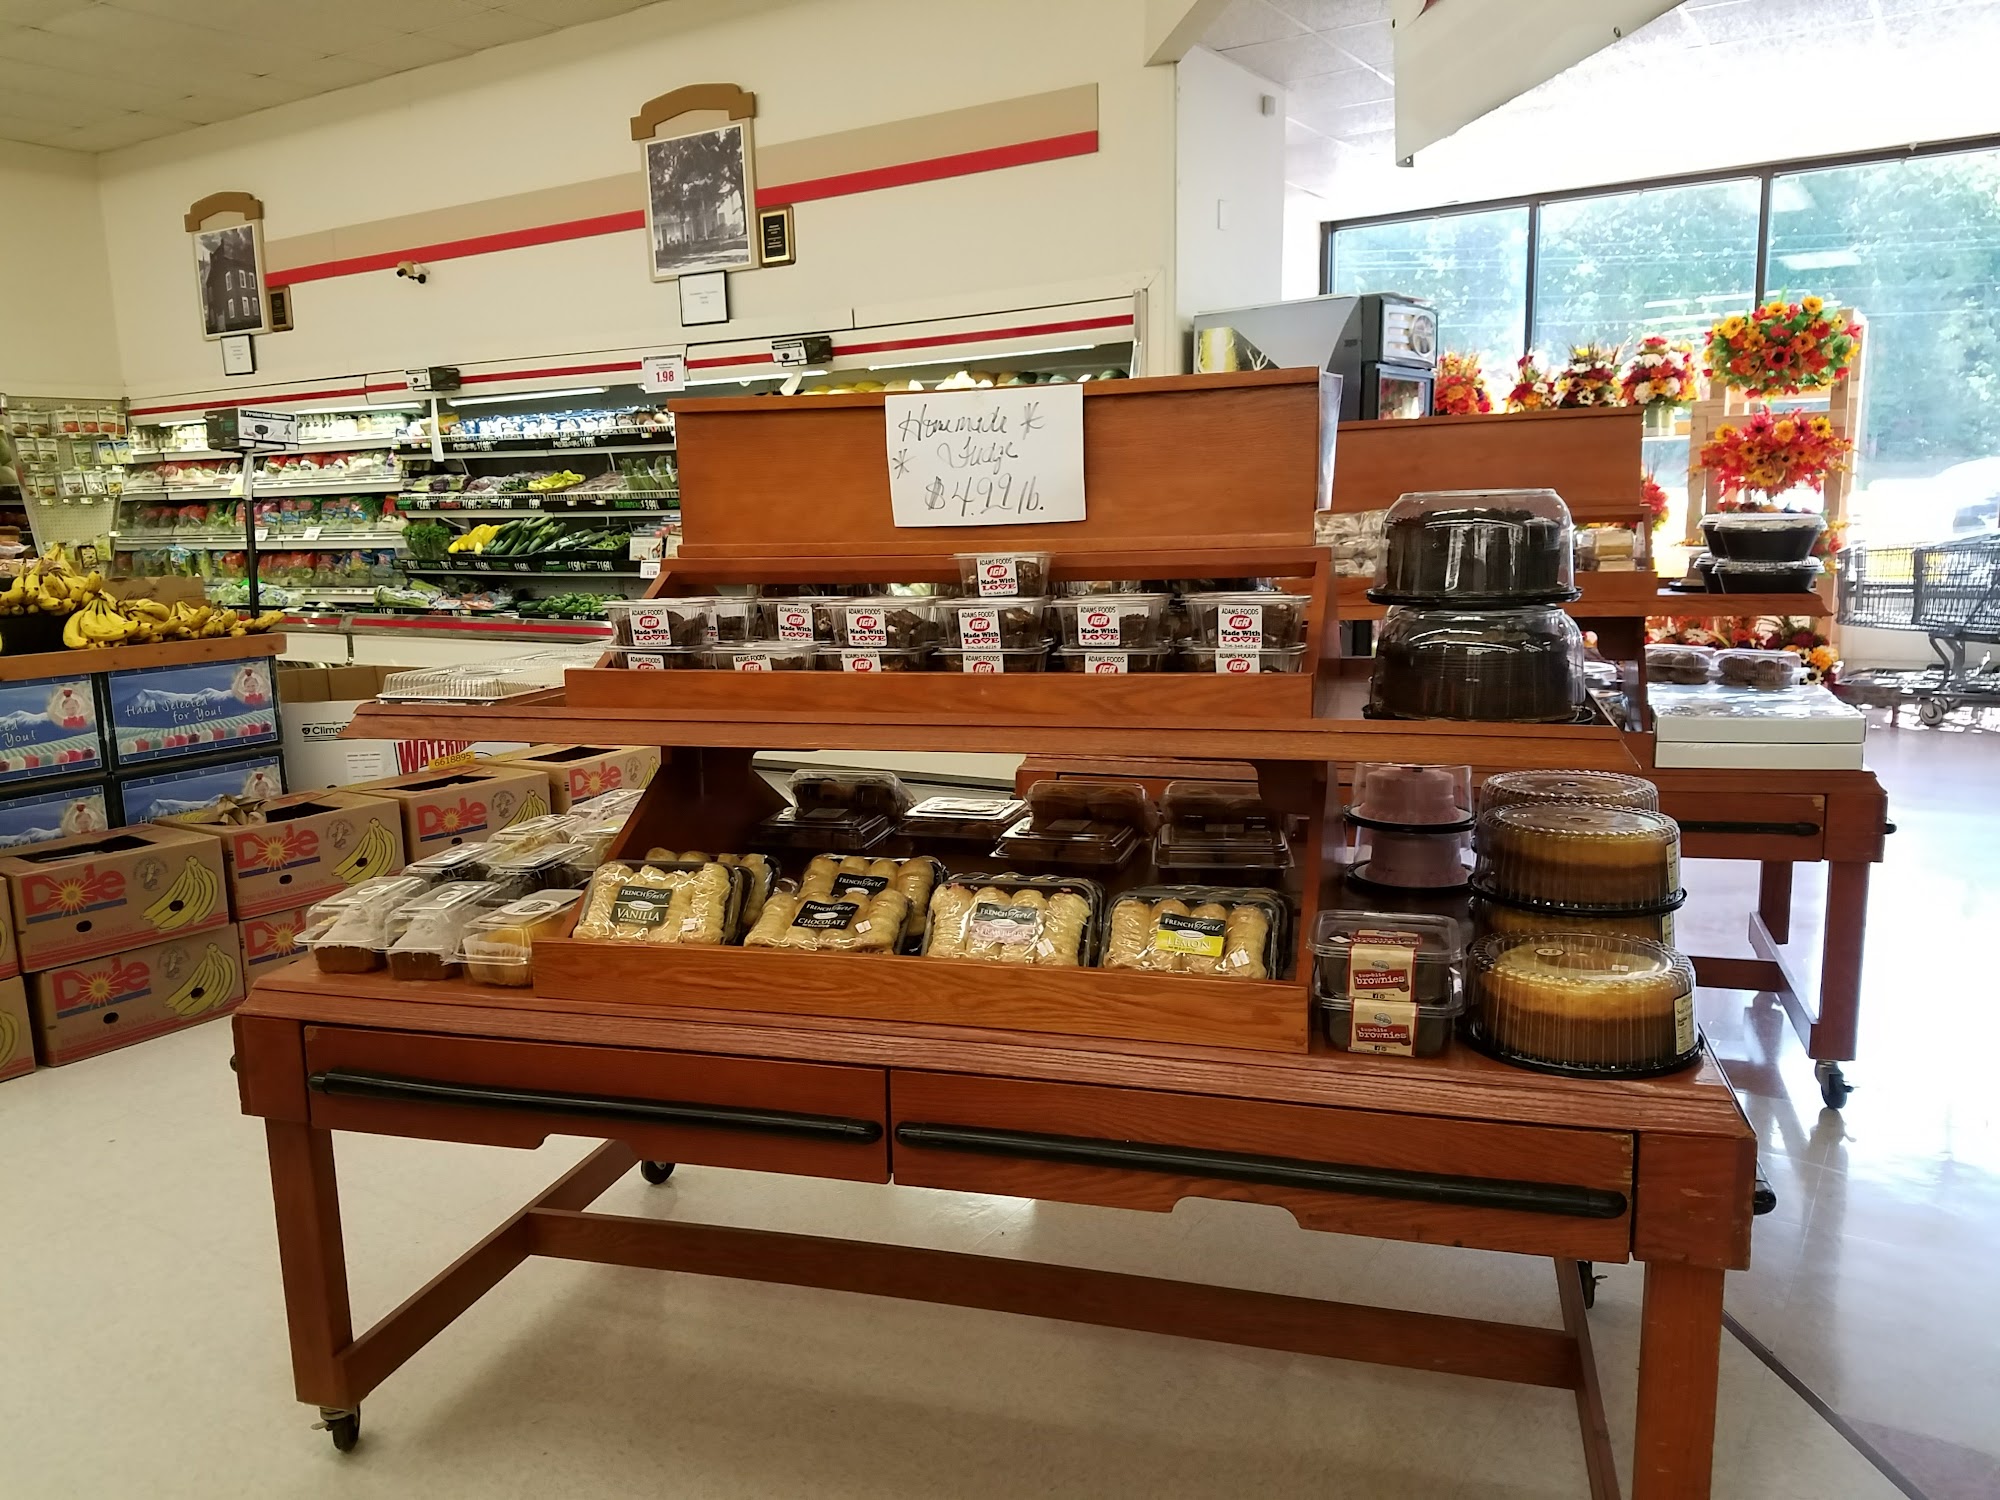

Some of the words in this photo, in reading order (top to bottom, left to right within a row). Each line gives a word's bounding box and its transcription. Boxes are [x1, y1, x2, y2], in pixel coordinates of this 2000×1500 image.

[656, 370, 675, 382] 1.98
[898, 404, 1008, 442] Homemade
[937, 436, 1019, 475] Fudge
[925, 473, 1013, 517] $4.99
[979, 558, 994, 566] ADAMS
[995, 557, 1012, 565] FOODS
[989, 566, 1005, 577] IGA
[978, 610, 995, 618] FOODS
[1098, 606, 1116, 614] FOODS
[641, 616, 657, 628] IGA
[788, 615, 804, 625] IGA
[858, 617, 875, 627] IGA
[971, 619, 988, 630] IGA
[1090, 615, 1108, 626] IGA
[1230, 617, 1251, 627] IGA
[854, 660, 871, 670] IGA
[1228, 661, 1249, 671] IGA
[125, 701, 157, 718] Hand
[162, 695, 208, 712] Selected
[173, 709, 190, 724] for
[193, 706, 223, 723] You!
[2, 730, 37, 748] You!
[434, 751, 473, 768] 6618895
[569, 761, 622, 798] Dole
[416, 797, 488, 836] Dole
[233, 823, 320, 870] Dole
[839, 877, 863, 885] FRENCH
[21, 864, 127, 916] Dole
[620, 889, 646, 898] FRENCH
[806, 903, 832, 912] FRENCH
[980, 907, 1008, 917] FRENCH
[617, 907, 660, 922] VANILLA
[797, 917, 847, 926] CHOCOLATE
[1164, 917, 1194, 929] FRENCH
[244, 910, 307, 958] Dol
[1167, 935, 1211, 950] LEMON
[52, 956, 151, 1012] Dole
[1354, 974, 1405, 985] brownies
[1356, 1029, 1407, 1040] brownies
